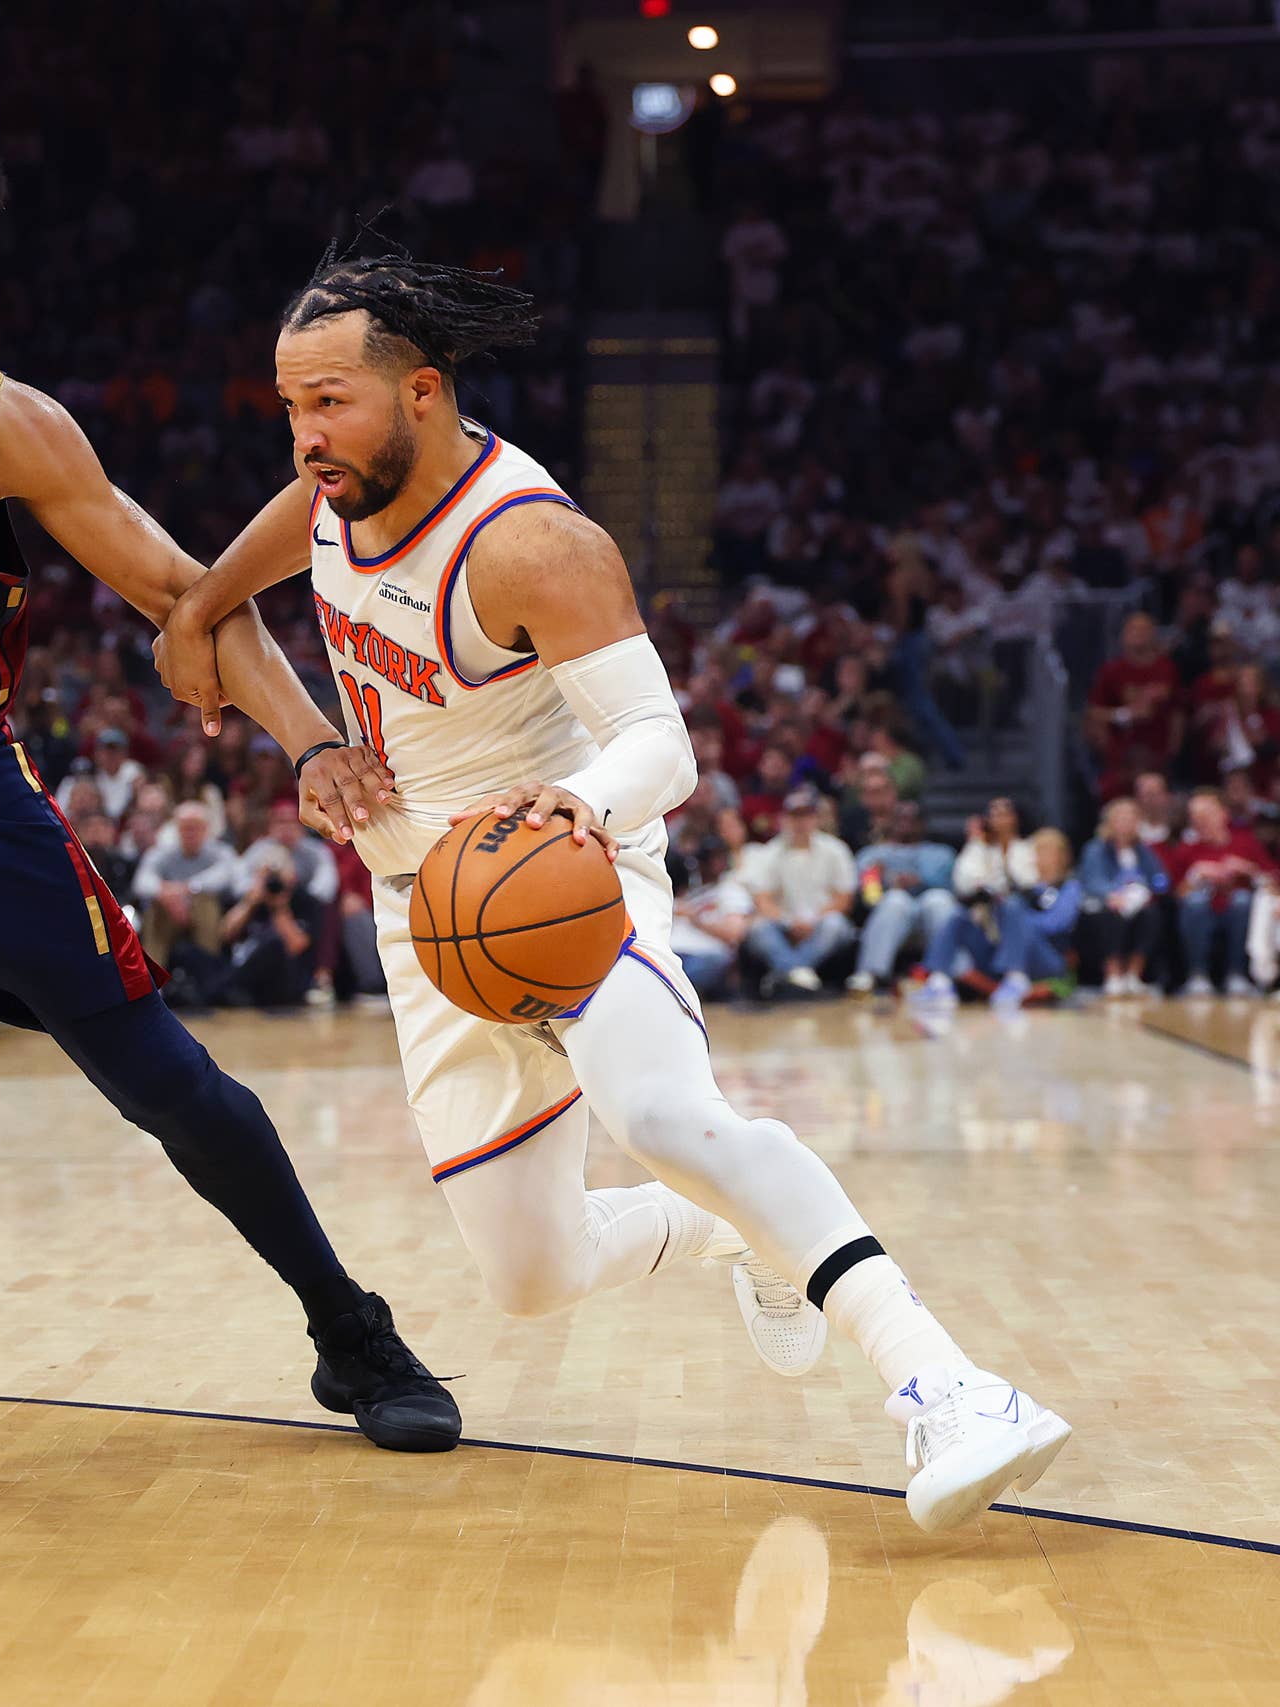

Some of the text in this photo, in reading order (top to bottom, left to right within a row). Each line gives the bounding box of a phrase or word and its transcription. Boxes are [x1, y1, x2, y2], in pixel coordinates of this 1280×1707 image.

[378, 588, 432, 613] abu dhabi
[345, 623, 447, 708] YORK
